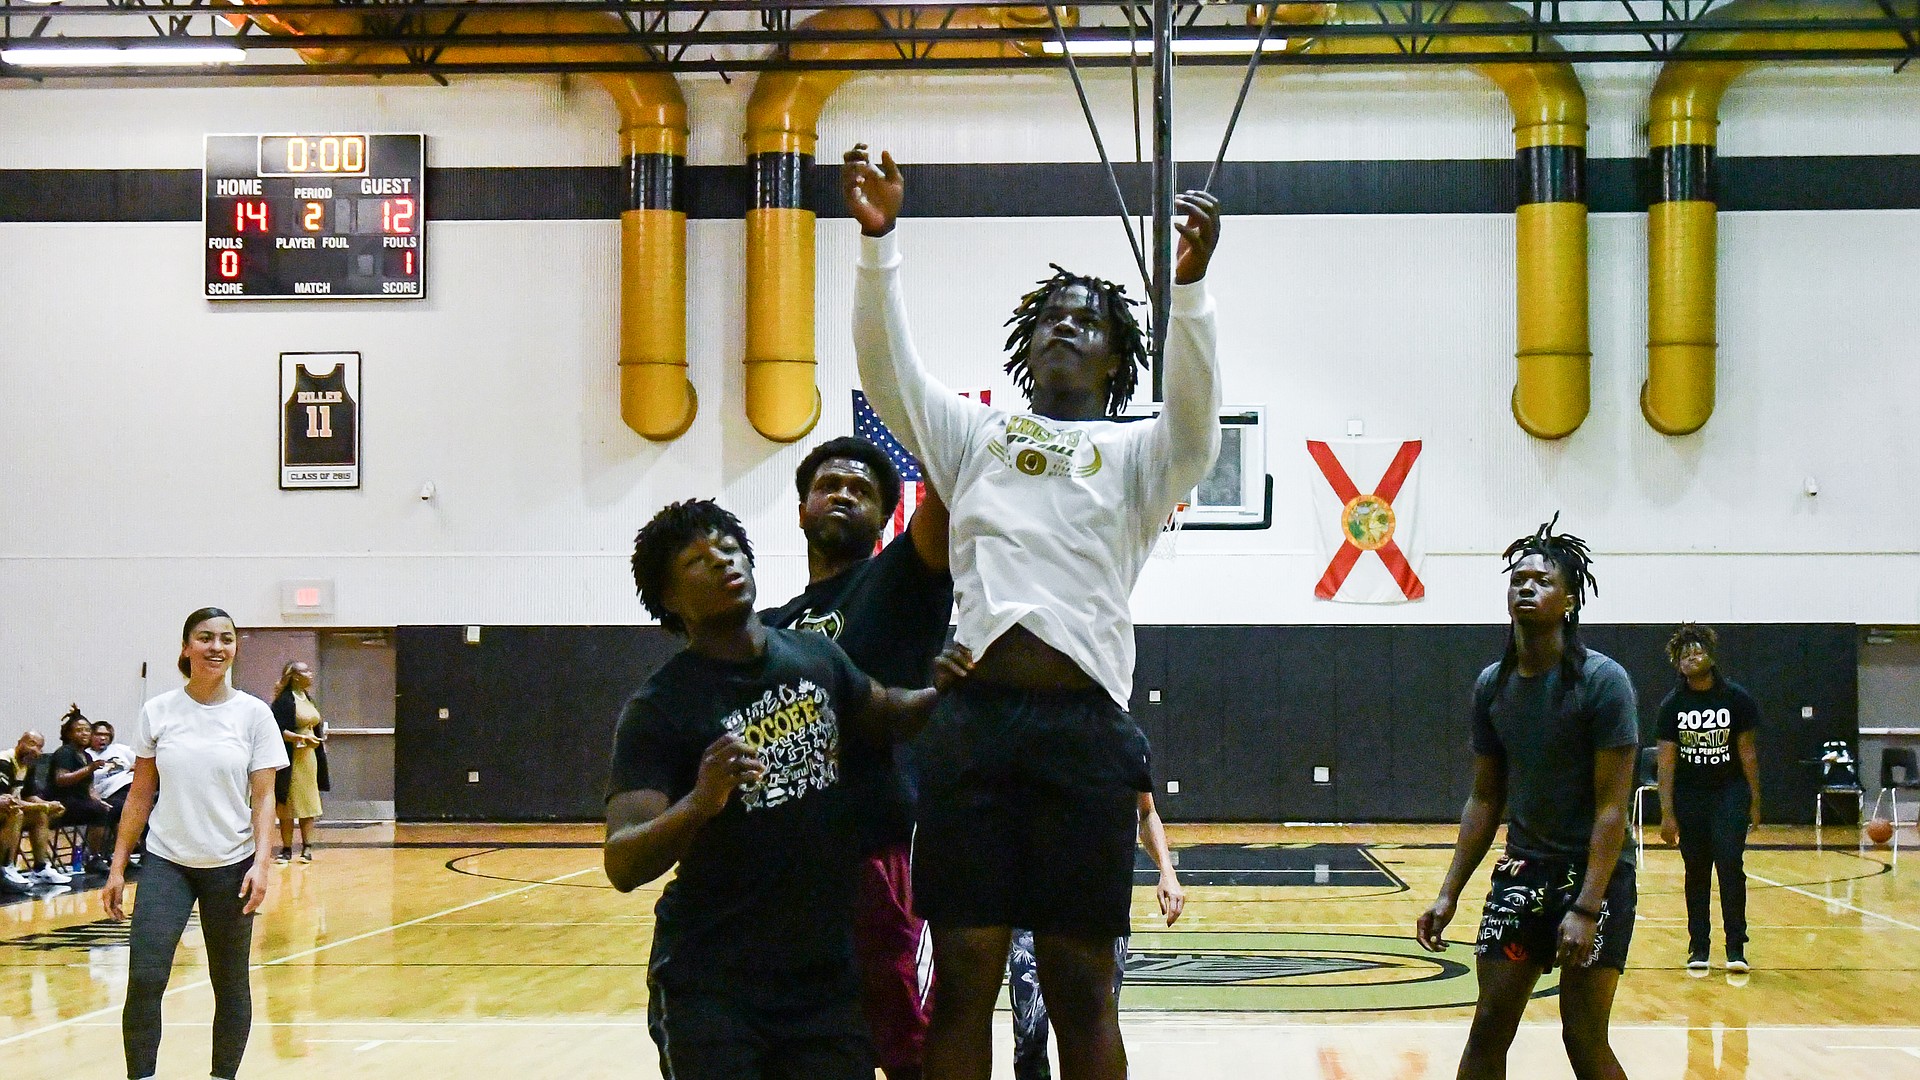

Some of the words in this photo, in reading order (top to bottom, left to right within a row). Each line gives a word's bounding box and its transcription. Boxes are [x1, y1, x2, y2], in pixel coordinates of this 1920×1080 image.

[287, 137, 365, 172] 0:00
[216, 179, 263, 196] HOME
[294, 187, 333, 200] PERIOD
[360, 178, 412, 195] GUEST
[236, 201, 269, 232] 14
[303, 202, 323, 231] 2
[382, 199, 414, 234] 12
[208, 237, 243, 249] FOULS
[275, 237, 316, 249] PLAYER
[322, 236, 350, 249] FOUL
[382, 236, 417, 248] FOULS
[220, 250, 239, 278] 0
[404, 250, 413, 275] 1
[208, 282, 244, 295] SCORE
[294, 282, 331, 294] MATCH
[382, 281, 417, 294] SCORE
[306, 405, 333, 438] 11
[744, 695, 819, 749] OCOEE
[1677, 708, 1731, 730] 2020
[1698, 745, 1729, 755] PERFECT
